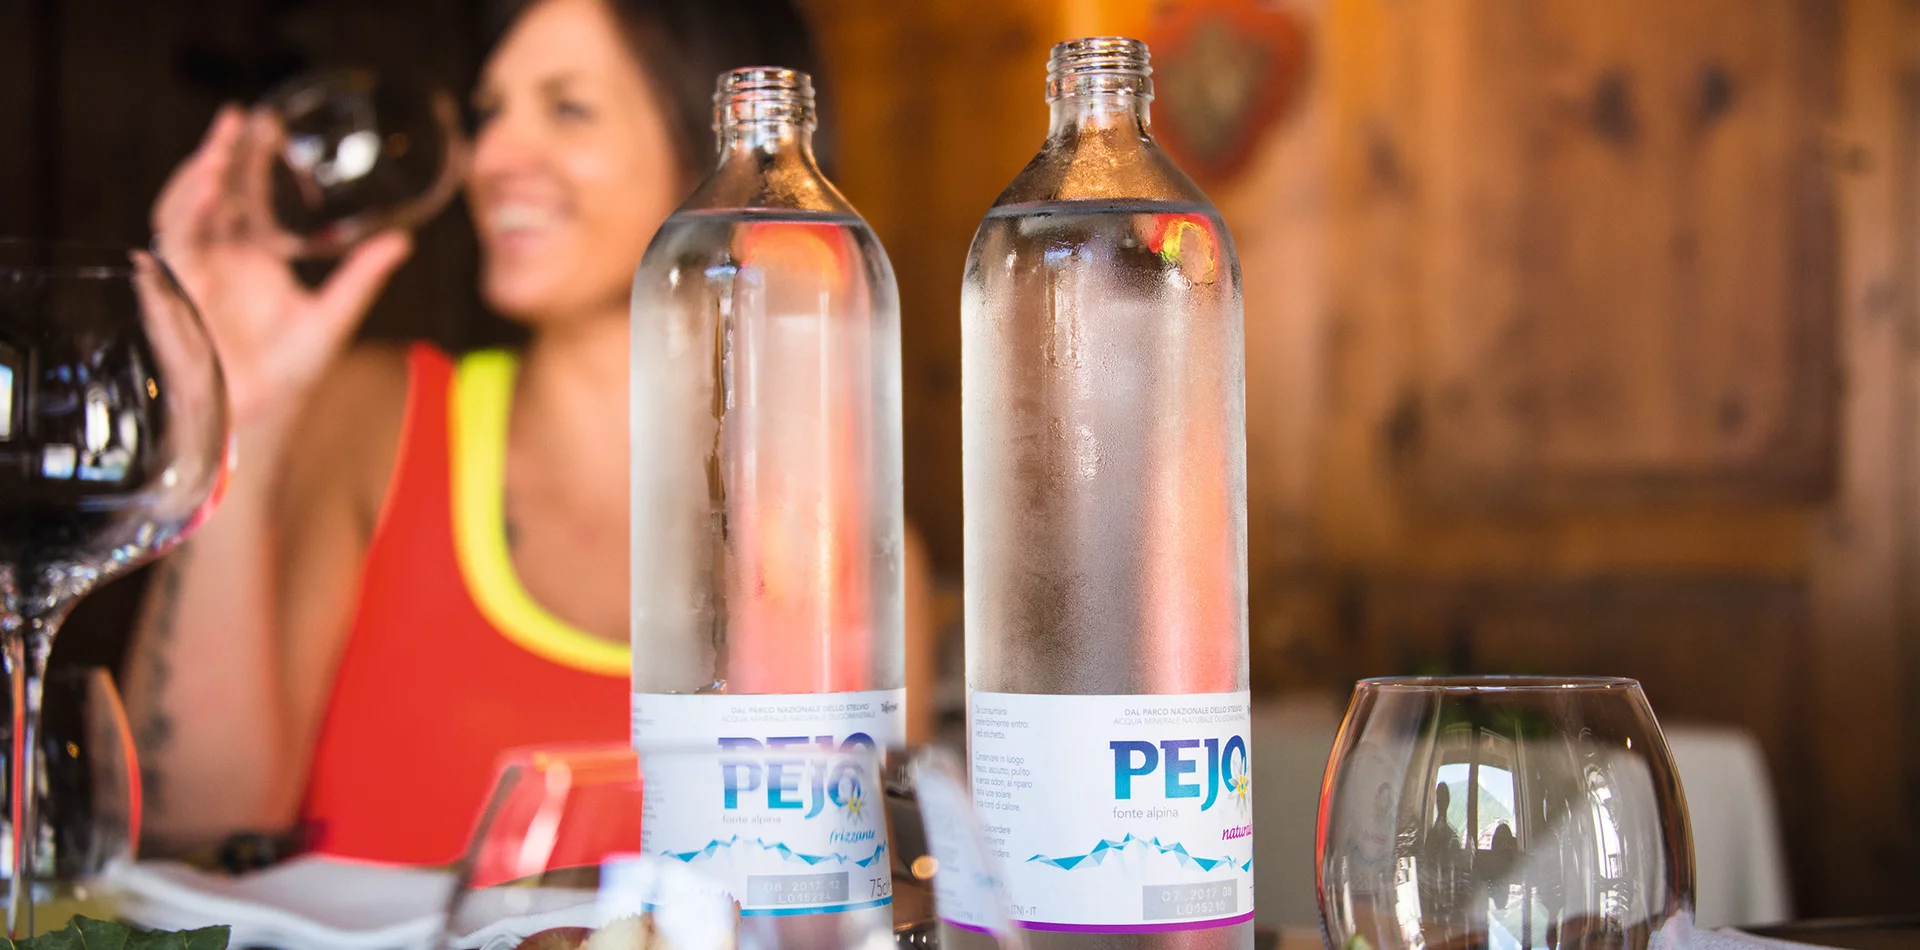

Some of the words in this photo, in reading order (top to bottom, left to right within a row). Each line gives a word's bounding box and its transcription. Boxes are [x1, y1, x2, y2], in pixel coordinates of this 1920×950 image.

[749, 706, 775, 714] PARCO
[778, 705, 821, 713] NAZIONALE
[823, 704, 845, 712] DELLO
[1142, 708, 1168, 716] PARCO
[1171, 706, 1208, 715] NAZIONALE
[1210, 706, 1226, 714] DELLO
[1113, 717, 1142, 726] ACQUA
[1144, 716, 1181, 725] MINERALE
[1183, 715, 1213, 724] NATURALE
[1007, 754, 1025, 766] luogo
[1012, 766, 1030, 779] pulito
[1110, 735, 1246, 811] PEJO
[718, 755, 872, 820] PEJO
[1013, 780, 1032, 790] riparo
[1112, 806, 1143, 818] fonte
[1147, 806, 1178, 820] alpina
[722, 814, 748, 824] fonte
[751, 814, 781, 825] alpina
[829, 828, 876, 845] frizzante
